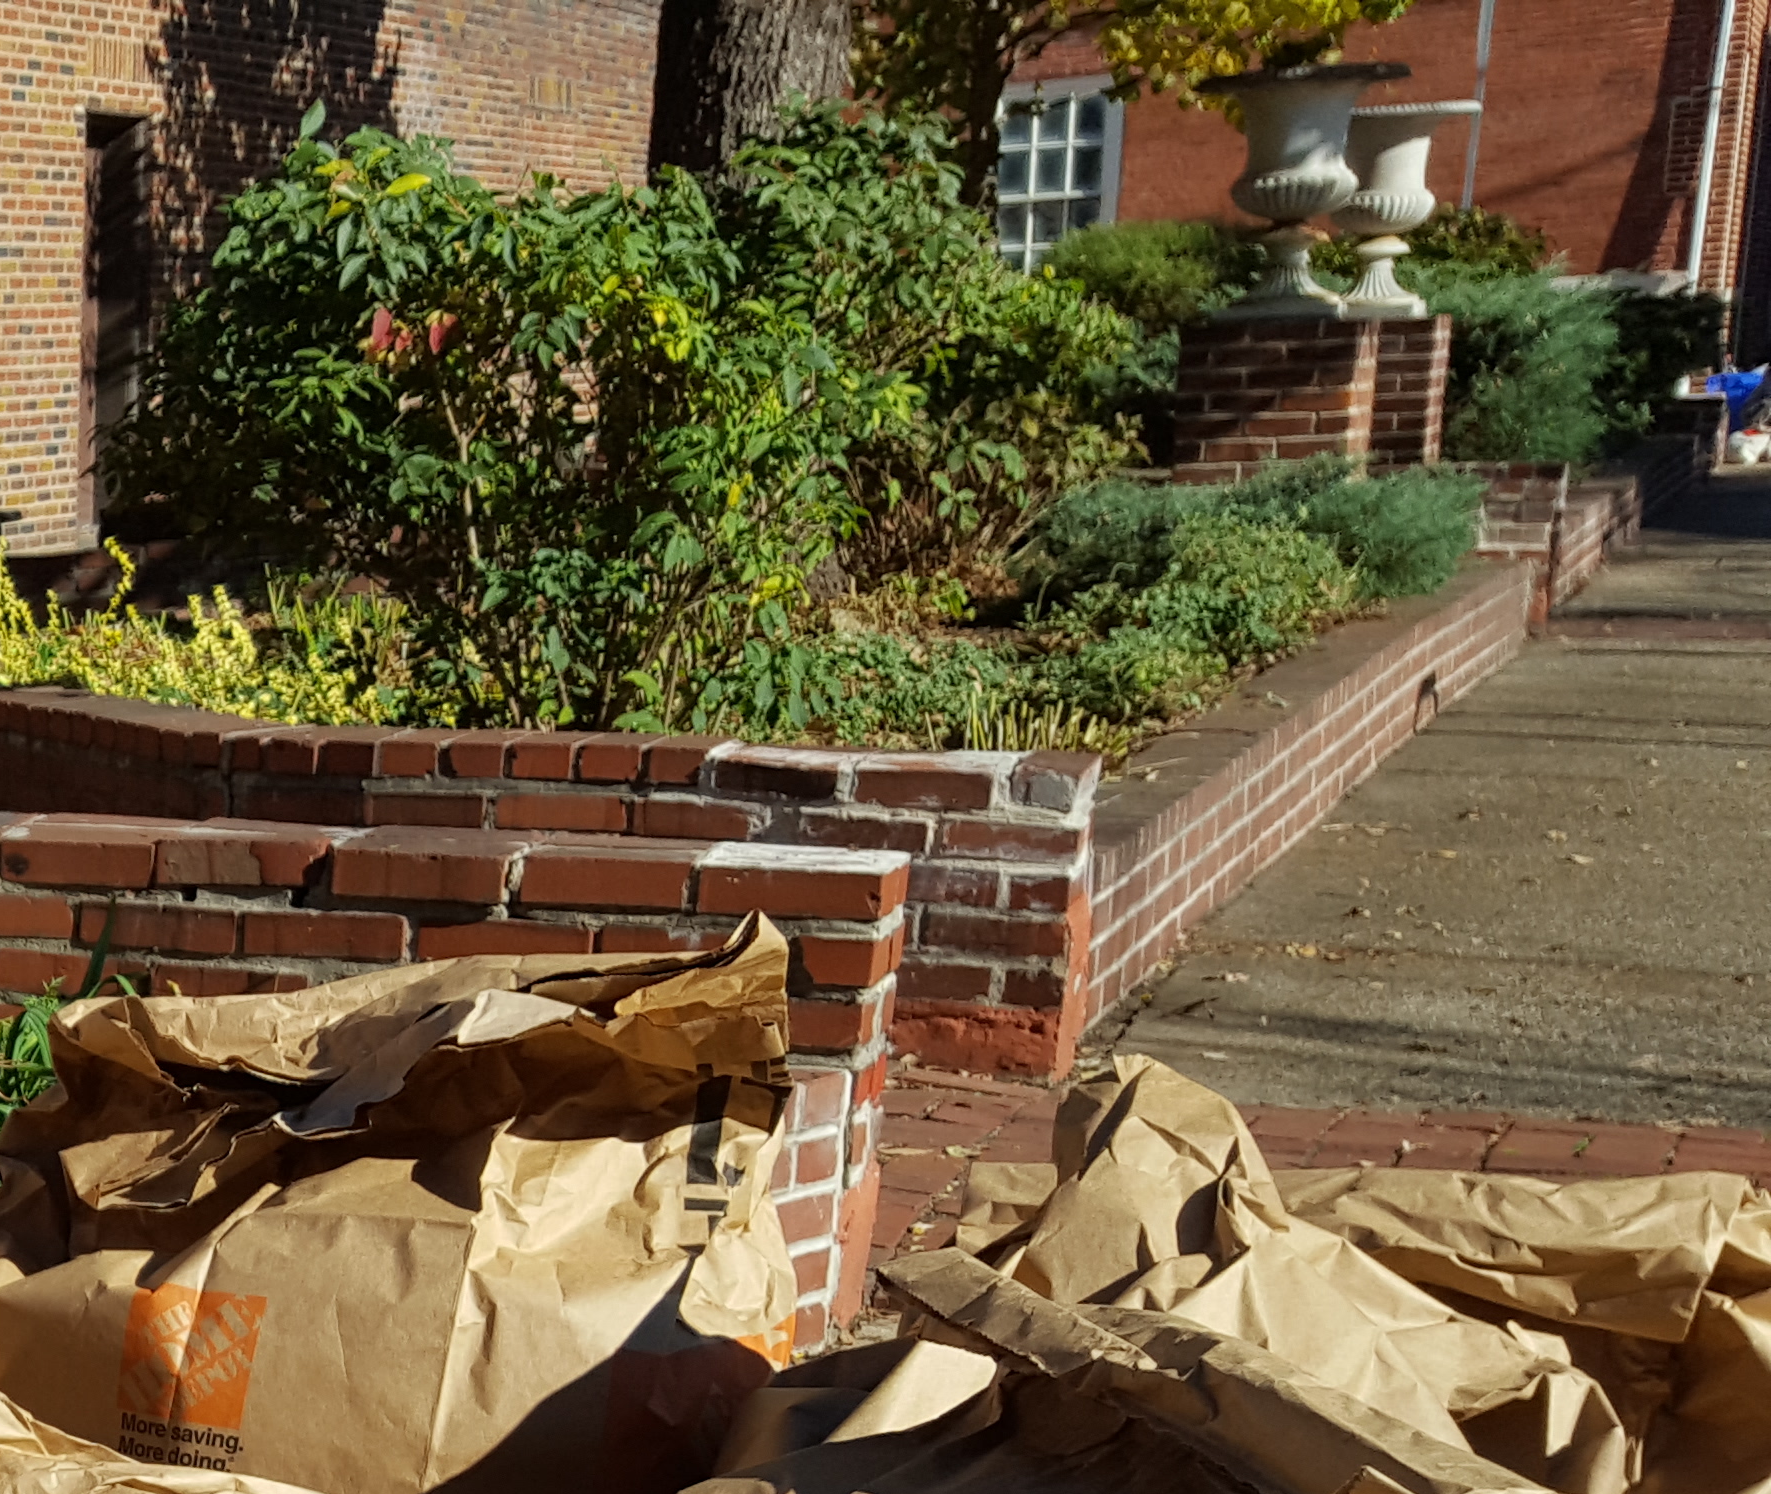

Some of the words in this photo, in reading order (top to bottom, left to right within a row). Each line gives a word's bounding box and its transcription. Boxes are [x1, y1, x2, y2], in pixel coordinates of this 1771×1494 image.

[117, 1435, 165, 1461] More
[121, 1411, 167, 1438] More
[170, 1427, 245, 1453] saving.
